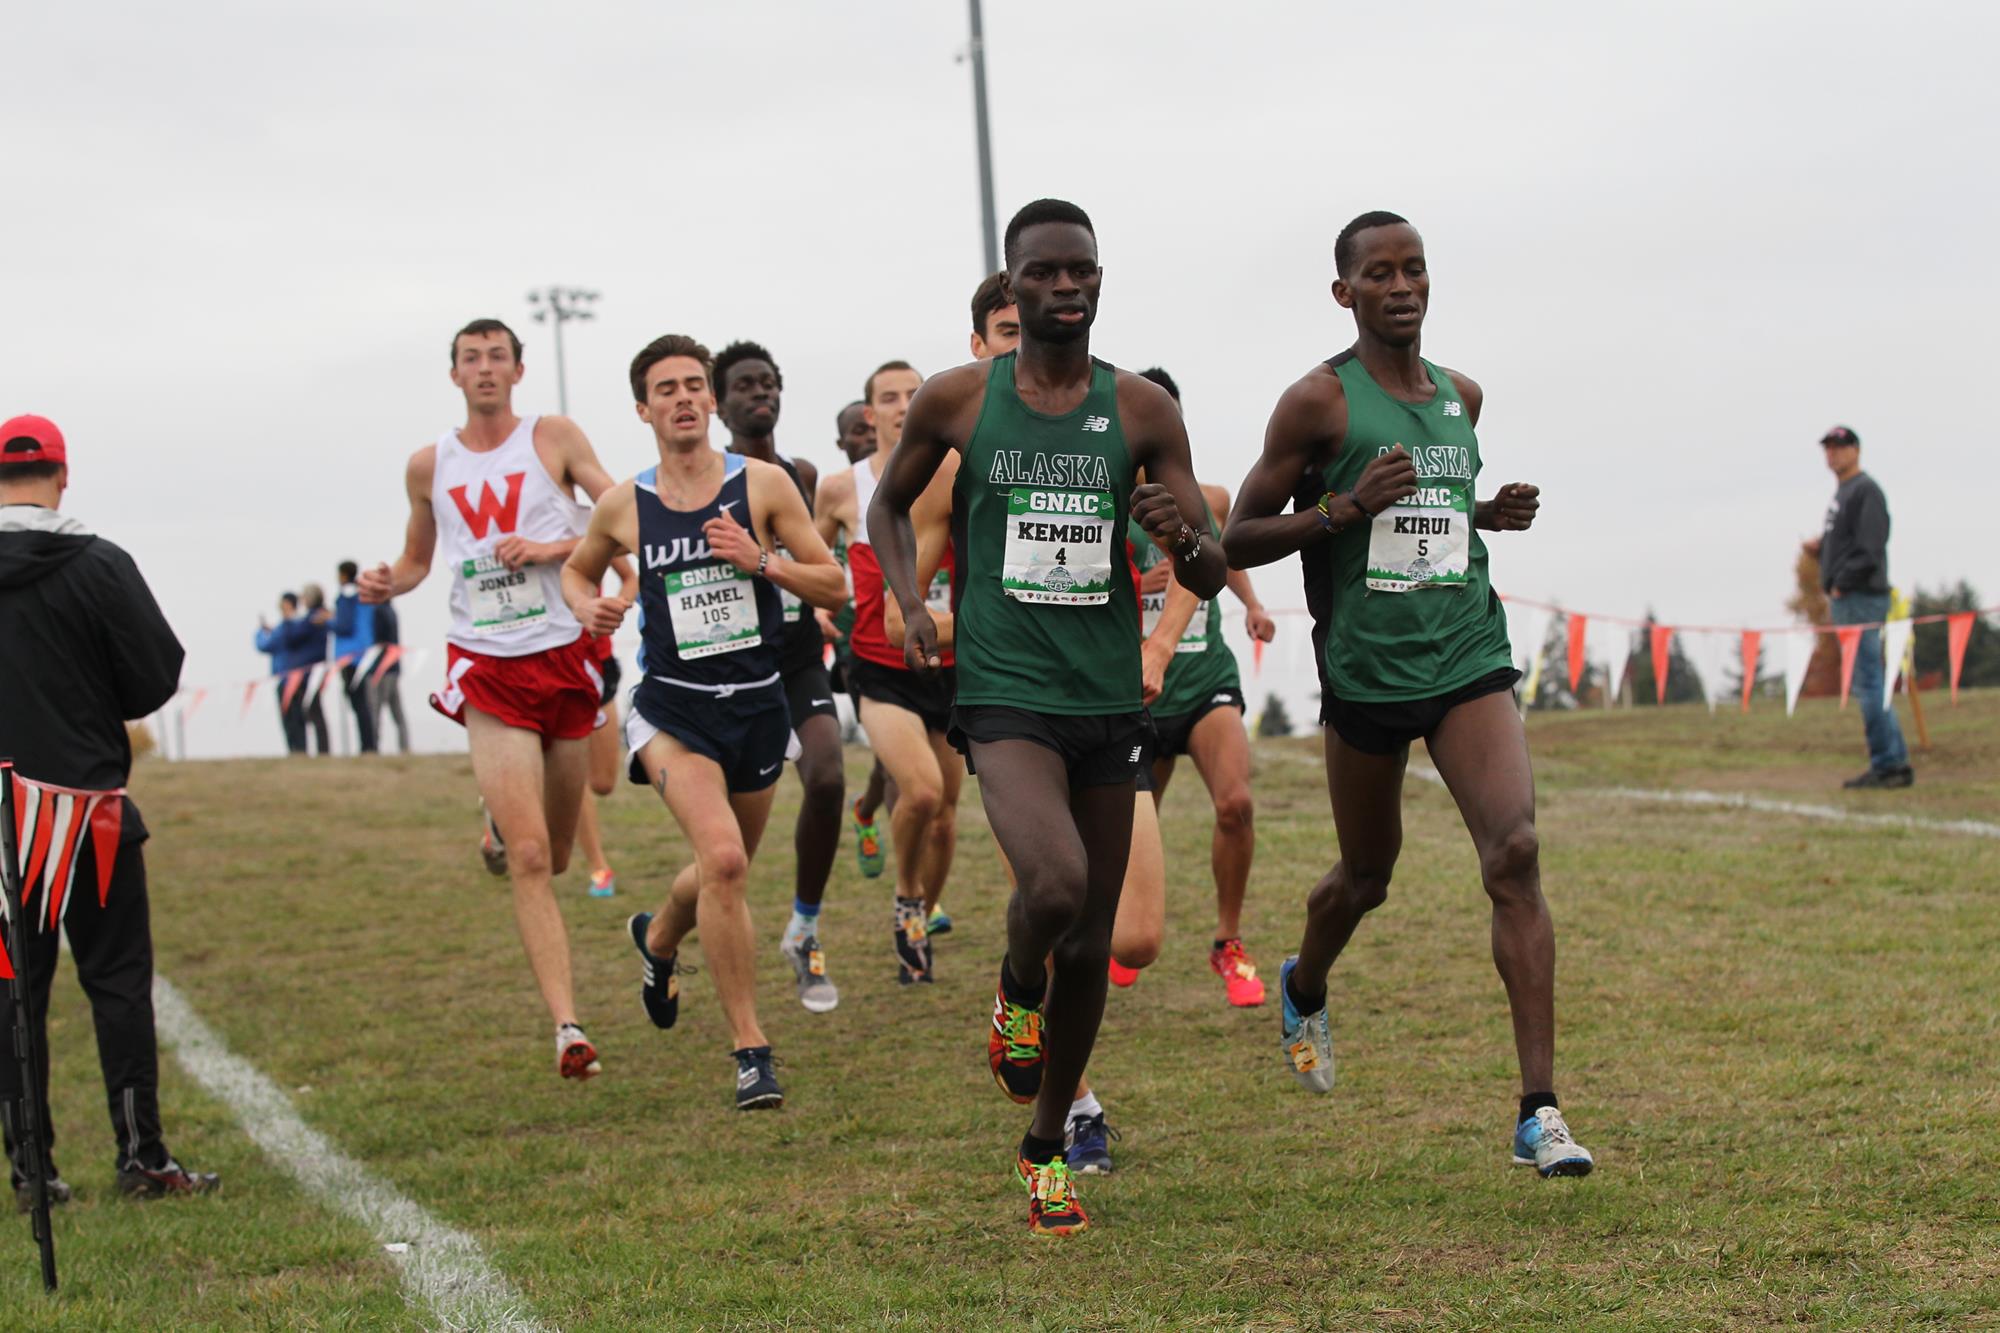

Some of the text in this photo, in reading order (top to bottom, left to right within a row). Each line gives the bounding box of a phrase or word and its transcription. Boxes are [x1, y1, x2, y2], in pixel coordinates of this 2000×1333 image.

[989, 450, 1111, 490] ALASKA
[1378, 446, 1472, 480] ASKA
[447, 471, 527, 541] W
[1029, 491, 1099, 514] GNAC
[1017, 521, 1103, 544] KEMBOI
[1393, 516, 1450, 535] KIRUI
[1055, 547, 1067, 566] 4
[1417, 539, 1428, 557] 5
[478, 571, 527, 592] JONES
[680, 564, 735, 587] GNAC
[680, 587, 744, 611] HAMEL
[702, 606, 731, 625] 105
